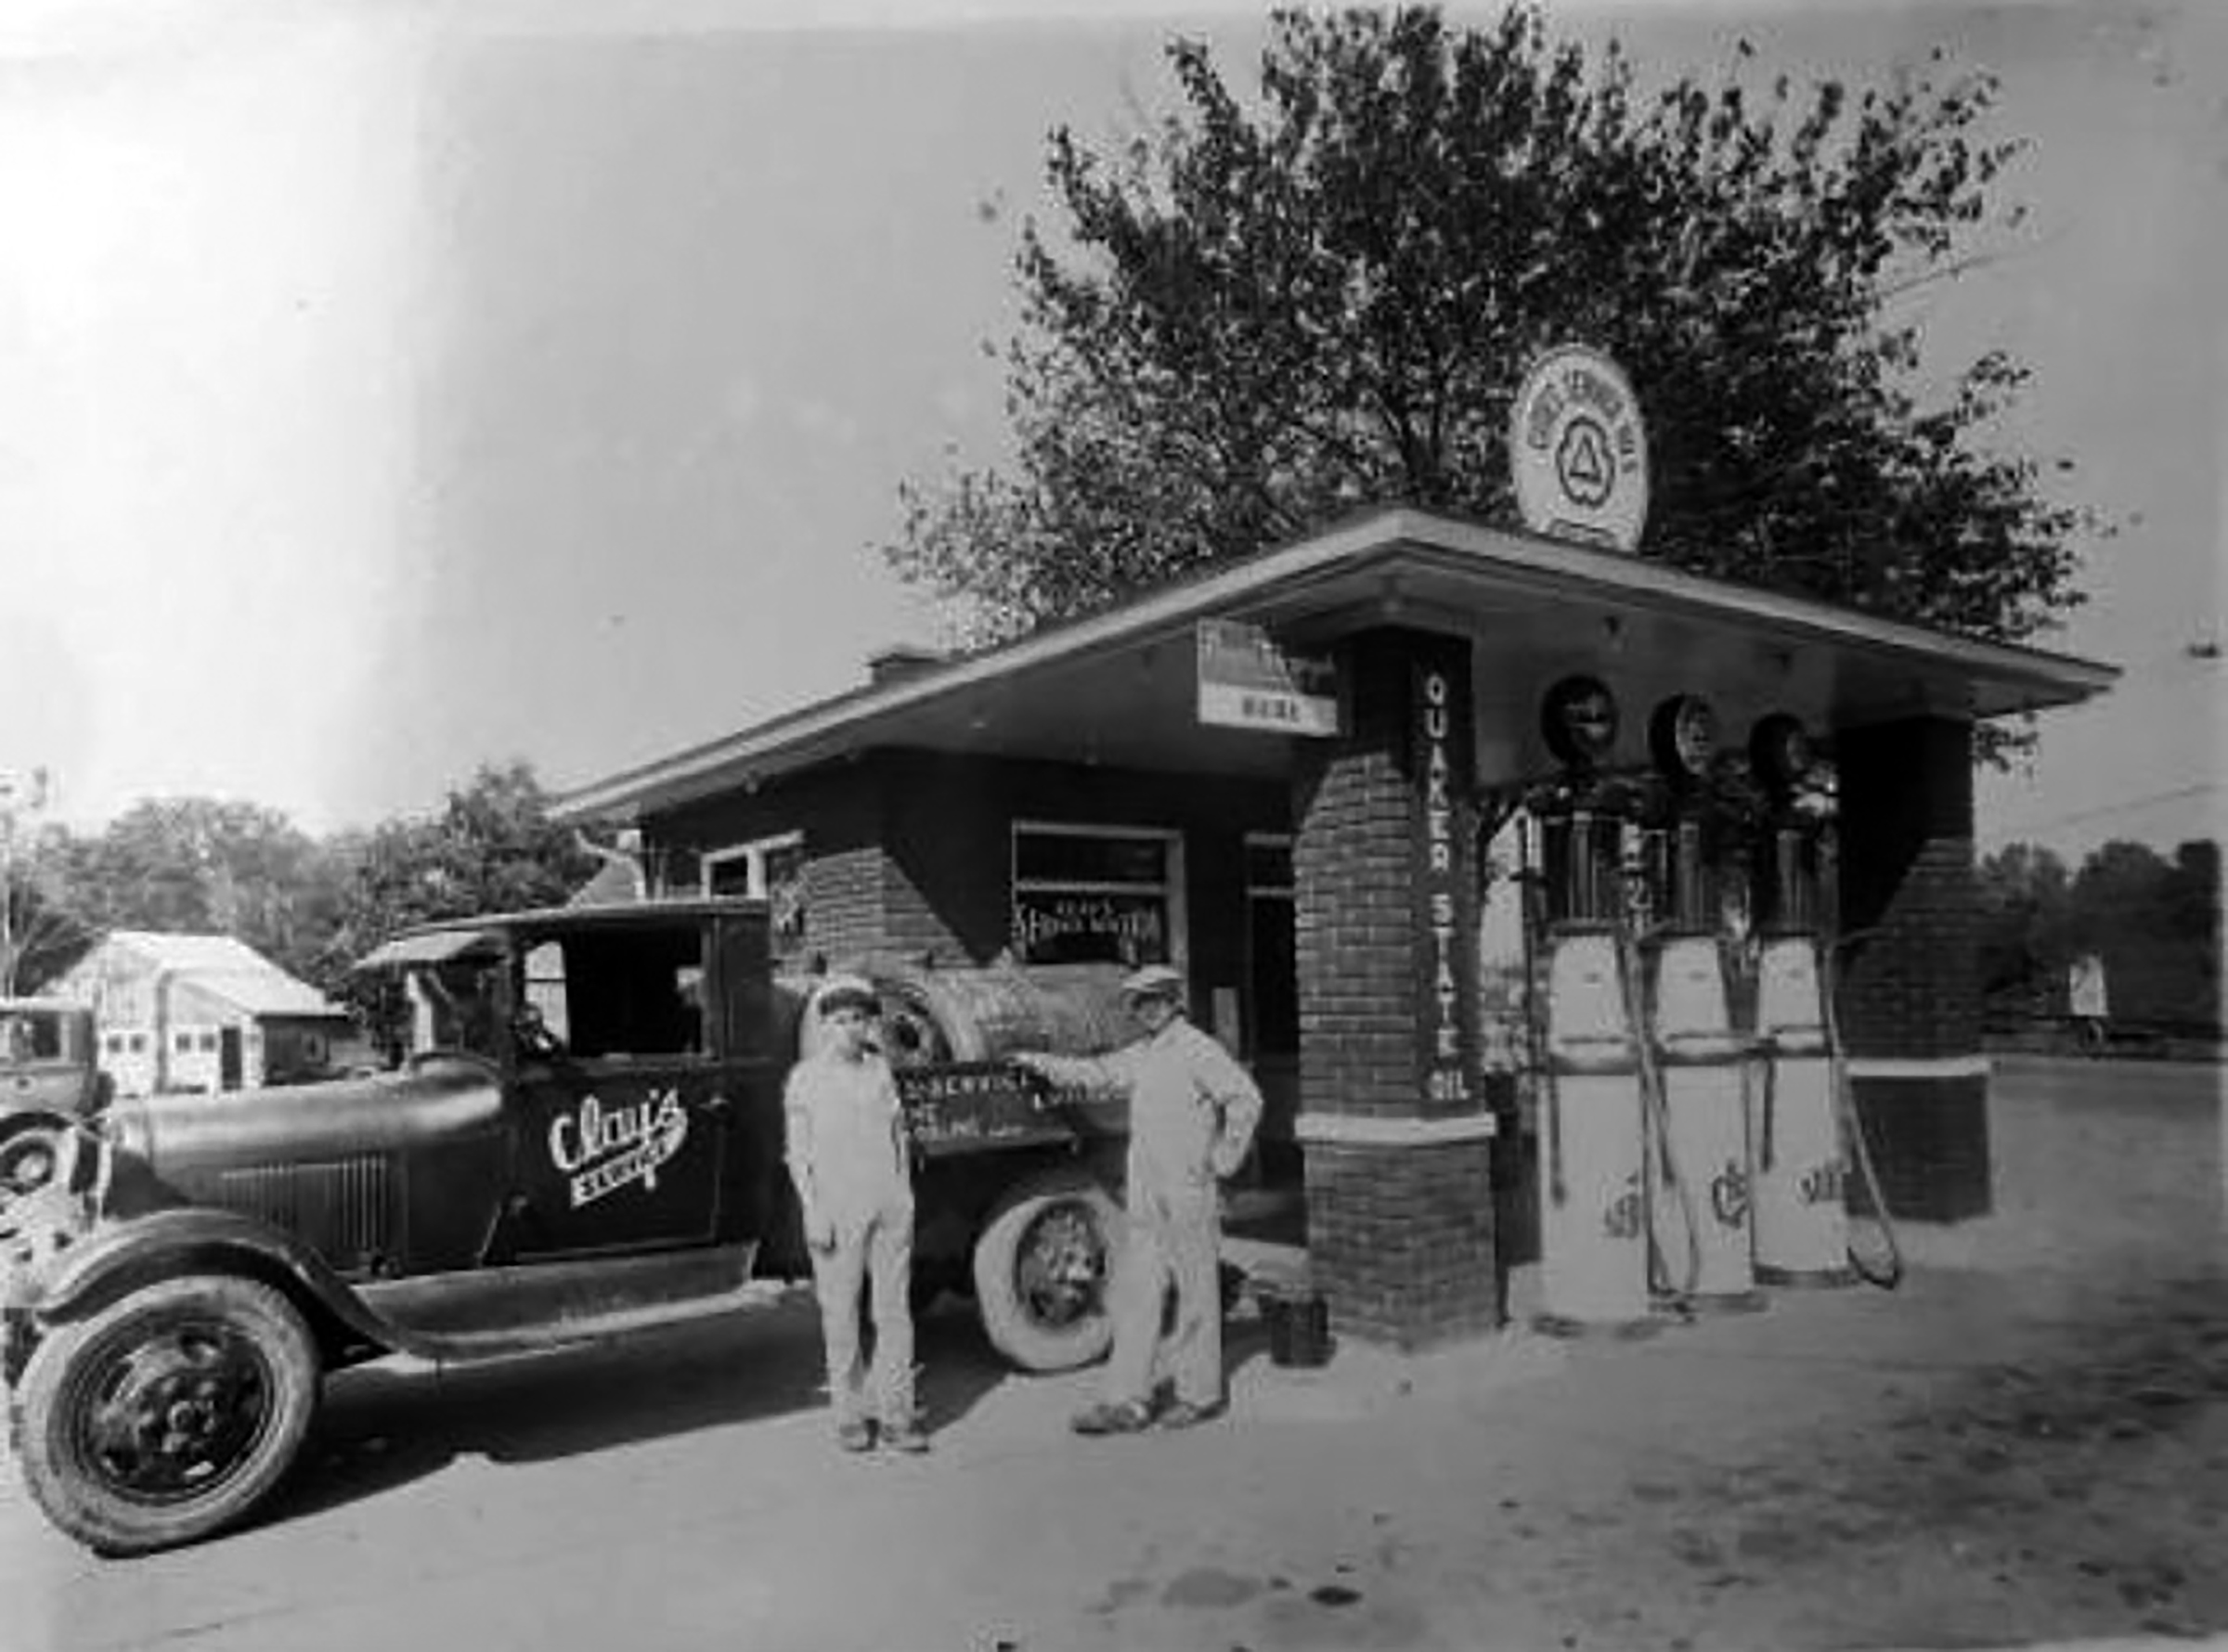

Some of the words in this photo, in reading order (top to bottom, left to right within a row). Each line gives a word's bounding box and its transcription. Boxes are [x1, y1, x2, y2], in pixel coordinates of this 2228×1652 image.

[1426, 675, 1450, 872] QUAKER
[1430, 893, 1457, 1058] STATE
[548, 1087, 689, 1171] Clay's
[1431, 1068, 1470, 1102] OIL
